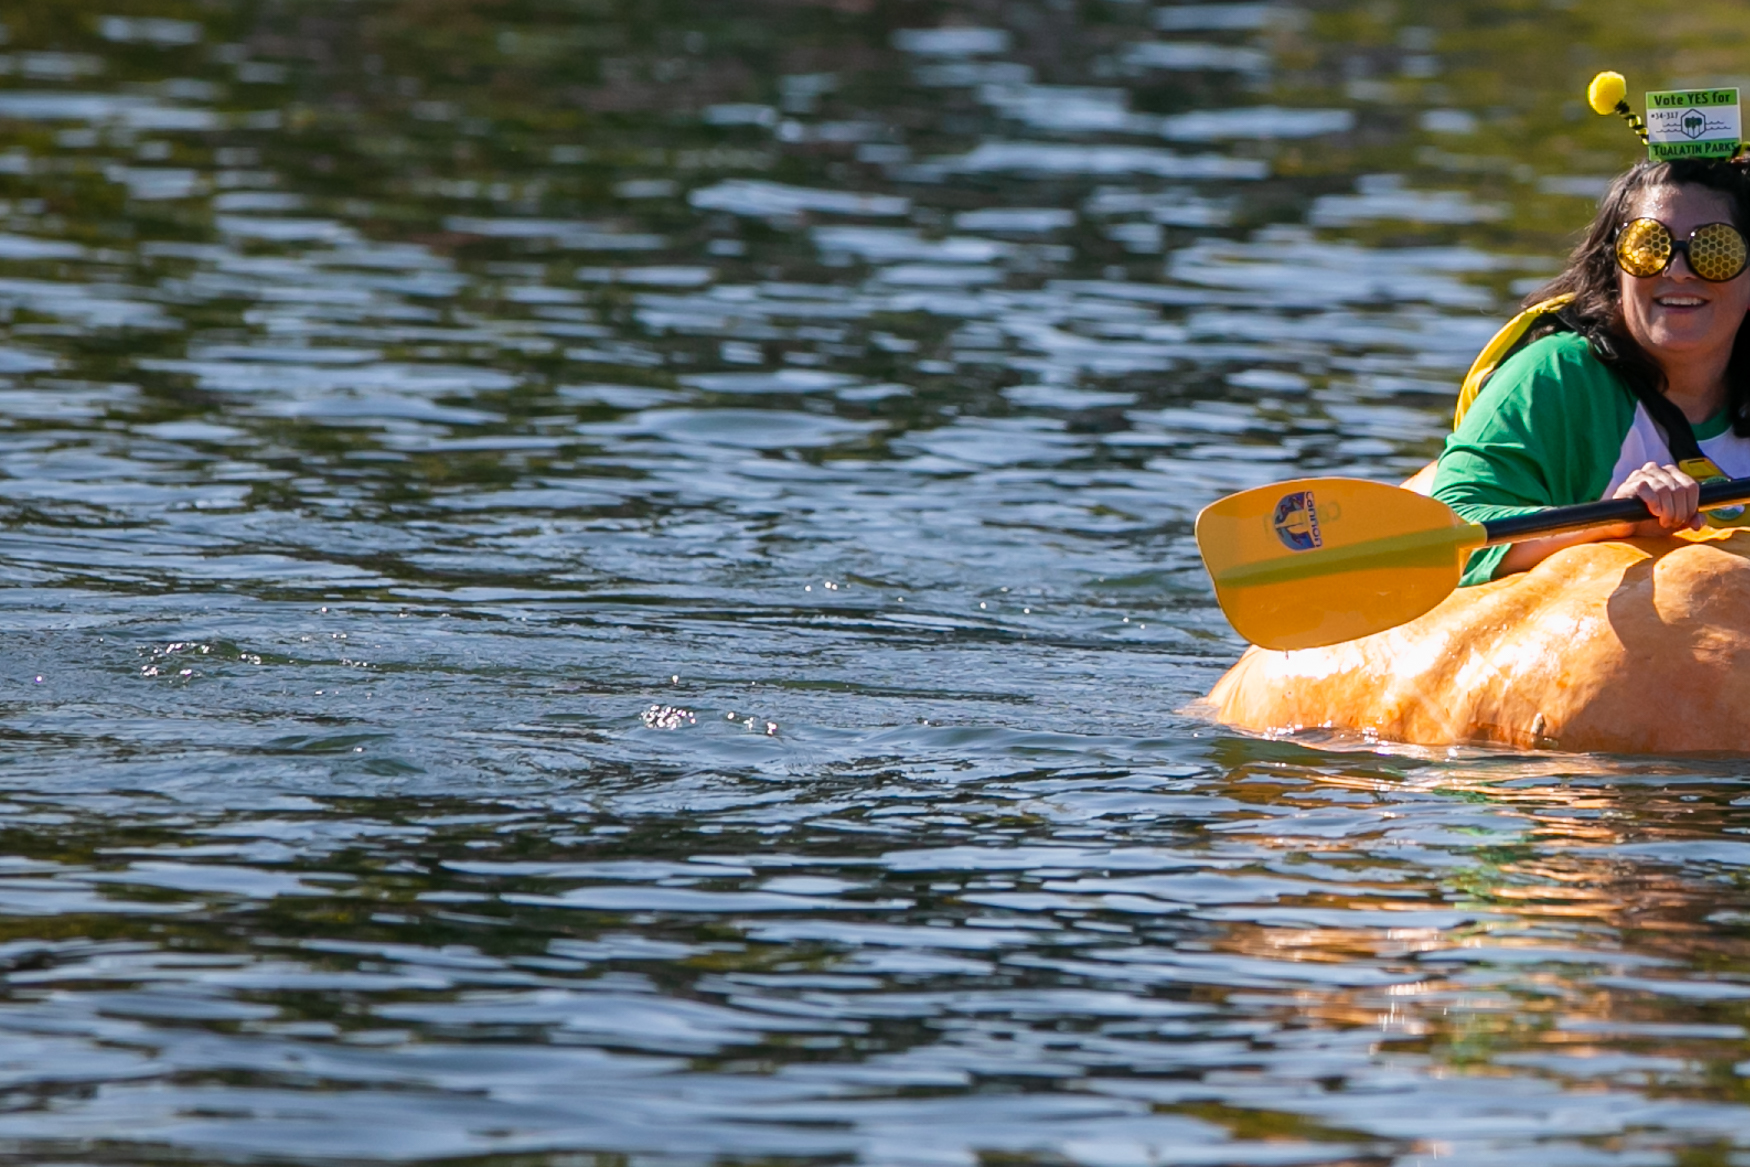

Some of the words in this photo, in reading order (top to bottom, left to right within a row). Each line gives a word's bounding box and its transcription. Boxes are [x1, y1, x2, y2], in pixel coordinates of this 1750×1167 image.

[1654, 95, 1684, 106] Vote
[1687, 92, 1708, 105] YES
[1712, 92, 1731, 103] for
